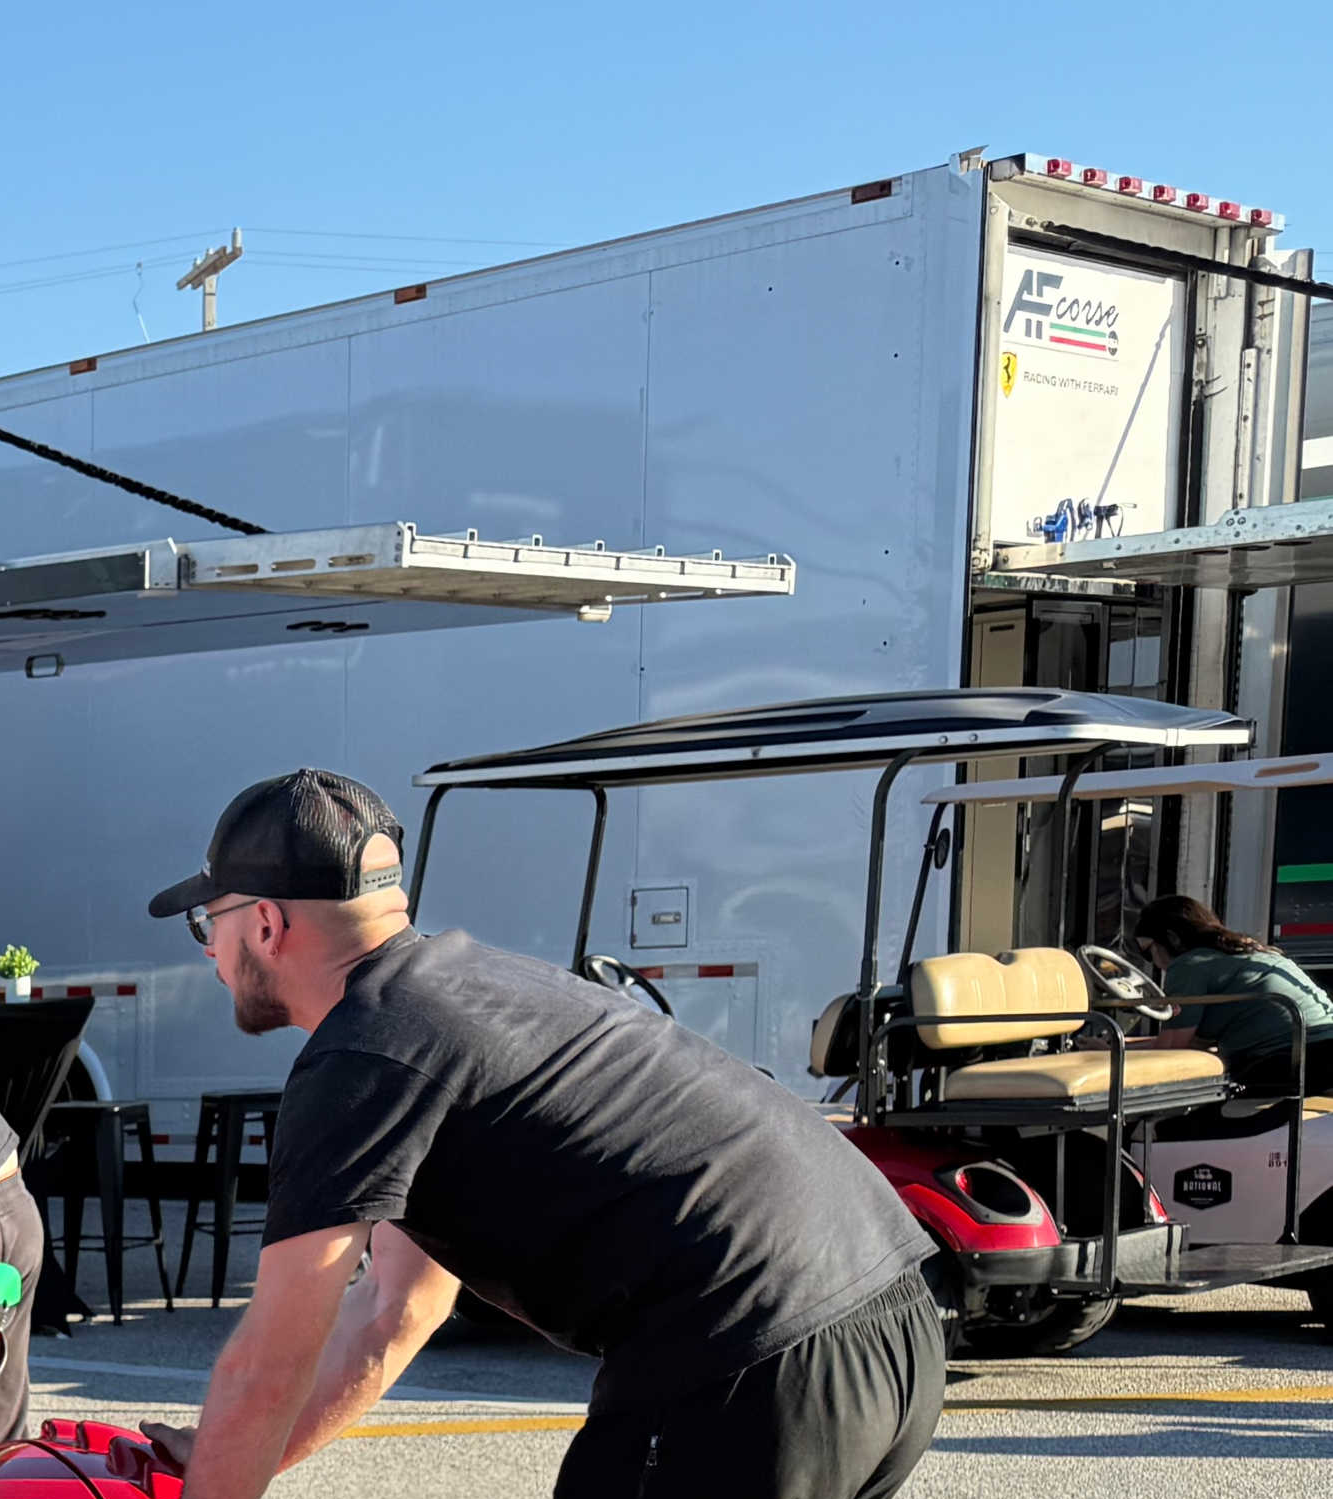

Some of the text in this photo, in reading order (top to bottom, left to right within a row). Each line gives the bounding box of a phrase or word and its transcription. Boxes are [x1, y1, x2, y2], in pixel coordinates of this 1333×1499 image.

[1056, 296, 1120, 328] corse
[1023, 371, 1119, 397] RACING WITH FERRARI
